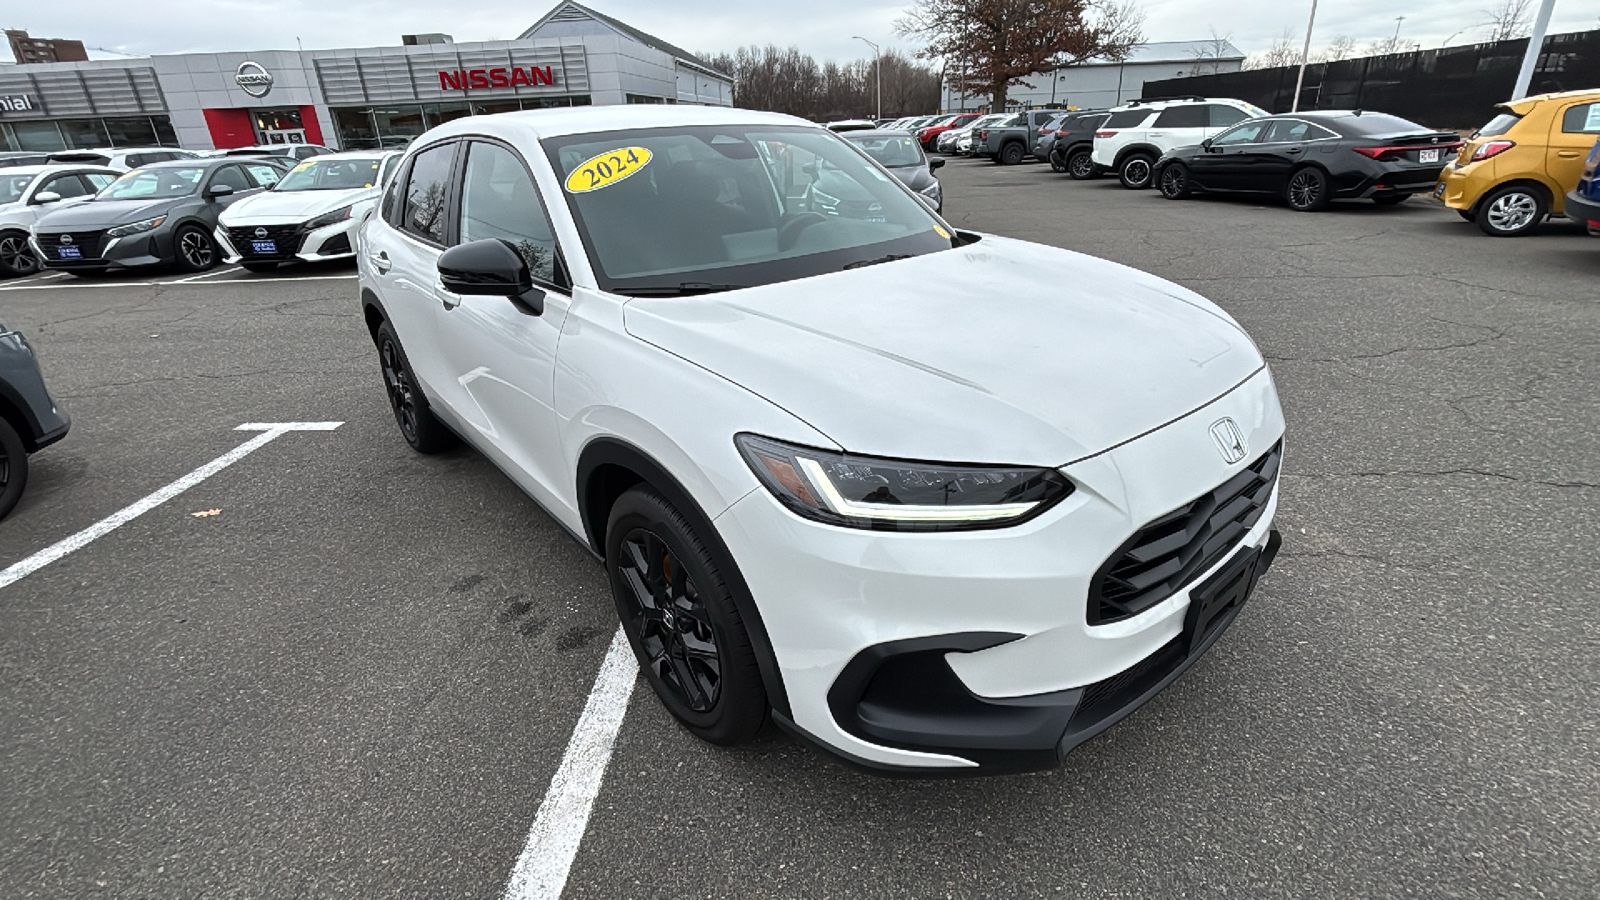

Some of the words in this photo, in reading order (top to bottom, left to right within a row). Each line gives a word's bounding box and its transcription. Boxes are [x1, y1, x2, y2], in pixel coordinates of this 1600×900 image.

[237, 74, 269, 83] NISSAN
[438, 65, 553, 90] NISSAN
[582, 149, 639, 187] 2024
